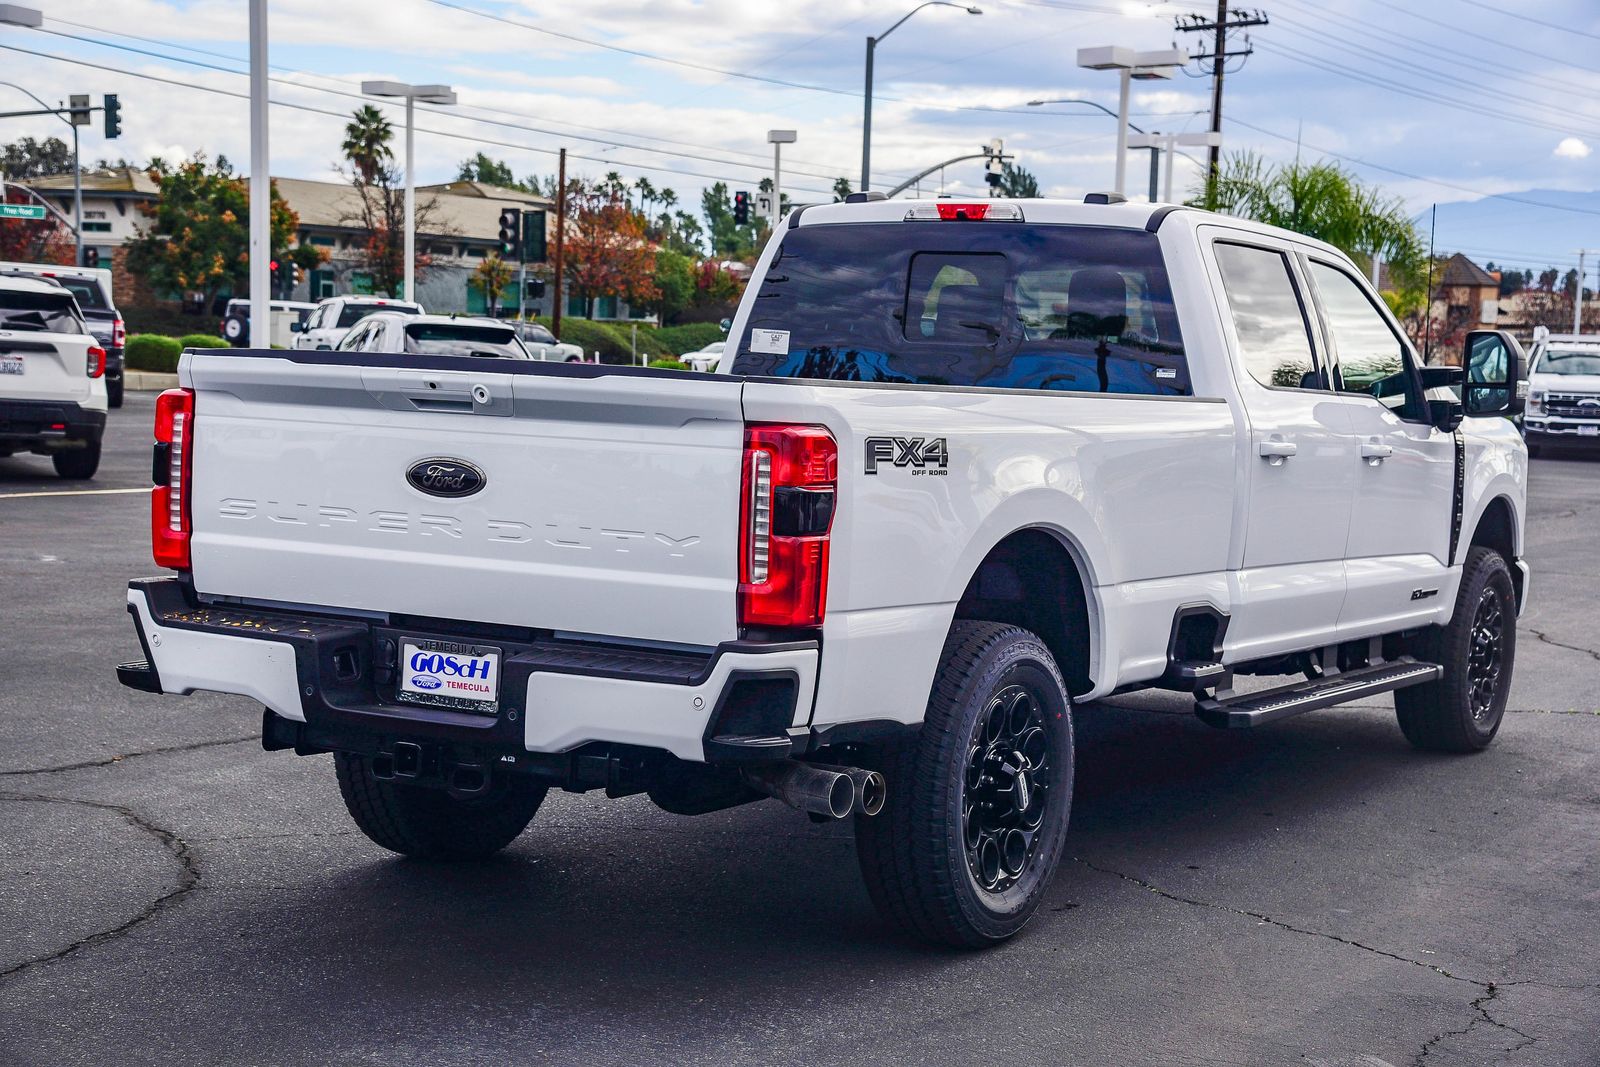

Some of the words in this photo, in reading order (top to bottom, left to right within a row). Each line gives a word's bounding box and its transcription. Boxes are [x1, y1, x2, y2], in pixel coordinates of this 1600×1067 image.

[864, 436, 948, 474] FX4
[422, 465, 466, 489] Ford
[219, 497, 462, 539] SUPER
[487, 518, 700, 558] DUTY
[423, 641, 477, 655] TEMECULA
[415, 677, 438, 689] Ford
[446, 680, 490, 693] TEMECULA
